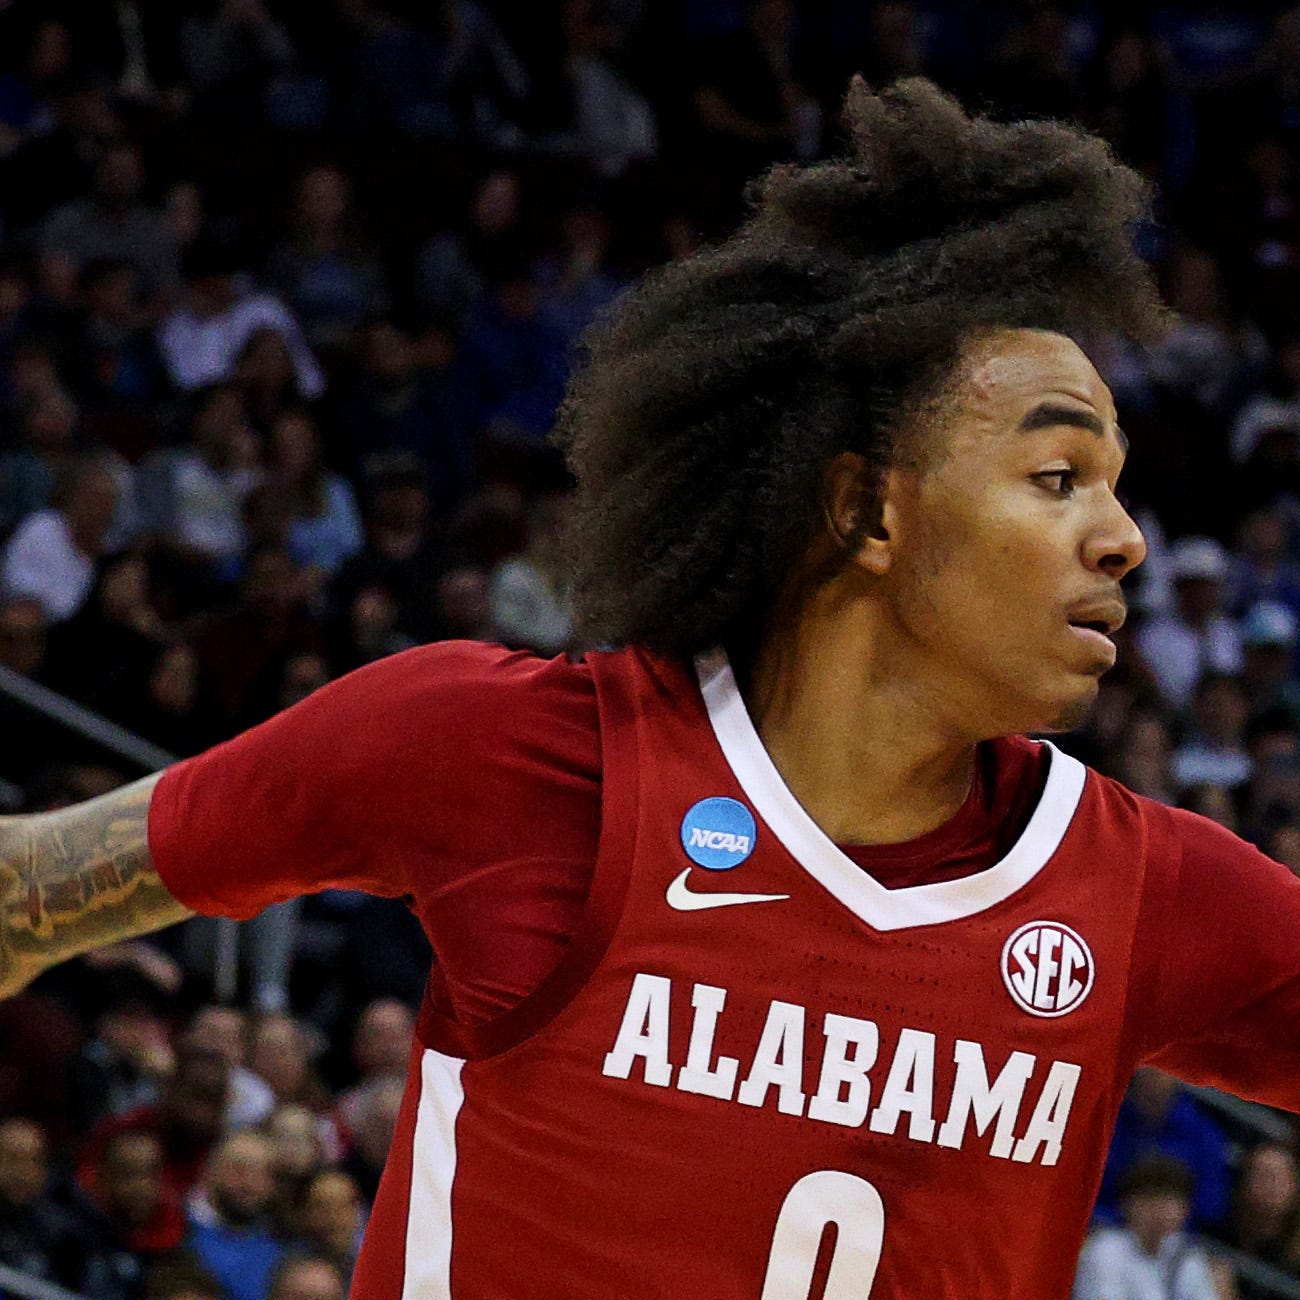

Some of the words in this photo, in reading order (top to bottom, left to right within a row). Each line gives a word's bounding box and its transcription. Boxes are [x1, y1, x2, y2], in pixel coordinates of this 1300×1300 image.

[689, 827, 750, 855] NCAA
[1010, 927, 1086, 1009] SEC
[603, 973, 1082, 1166] ALABAMA
